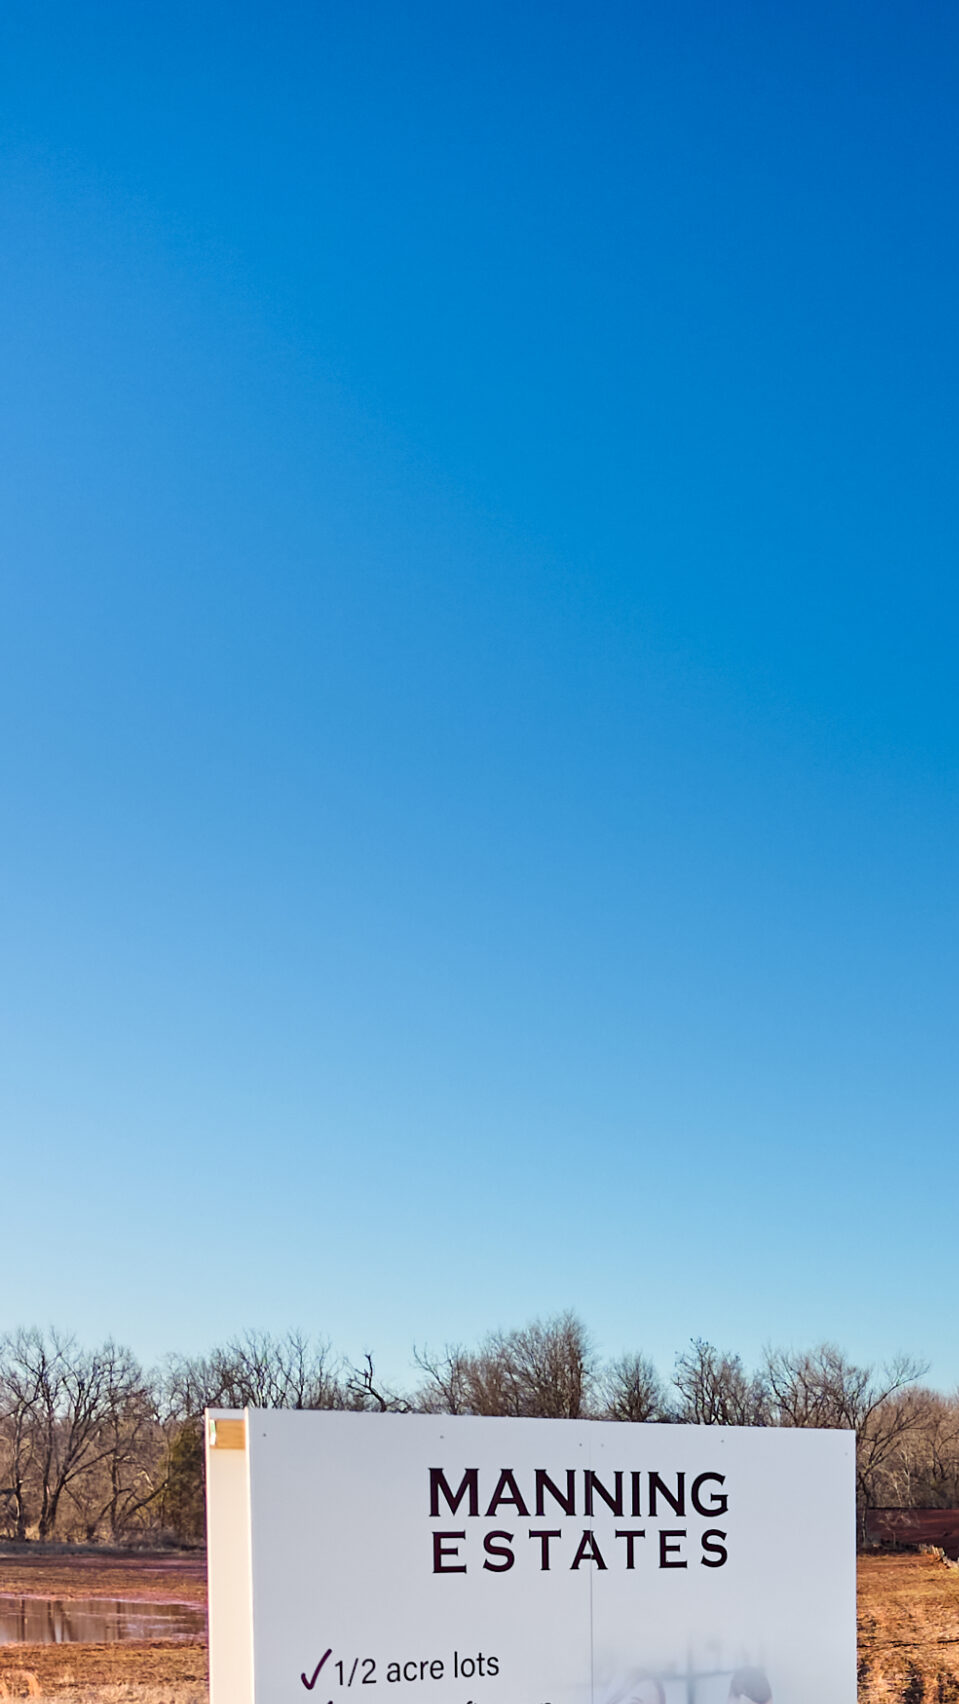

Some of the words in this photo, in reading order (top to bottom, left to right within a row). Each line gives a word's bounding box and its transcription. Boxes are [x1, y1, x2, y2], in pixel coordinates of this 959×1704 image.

[428, 1467, 729, 1518] MANNING
[432, 1529, 729, 1574] ESTATES
[334, 1658, 377, 1687] 1/2
[386, 1660, 444, 1683] acre
[453, 1651, 499, 1678] lots
